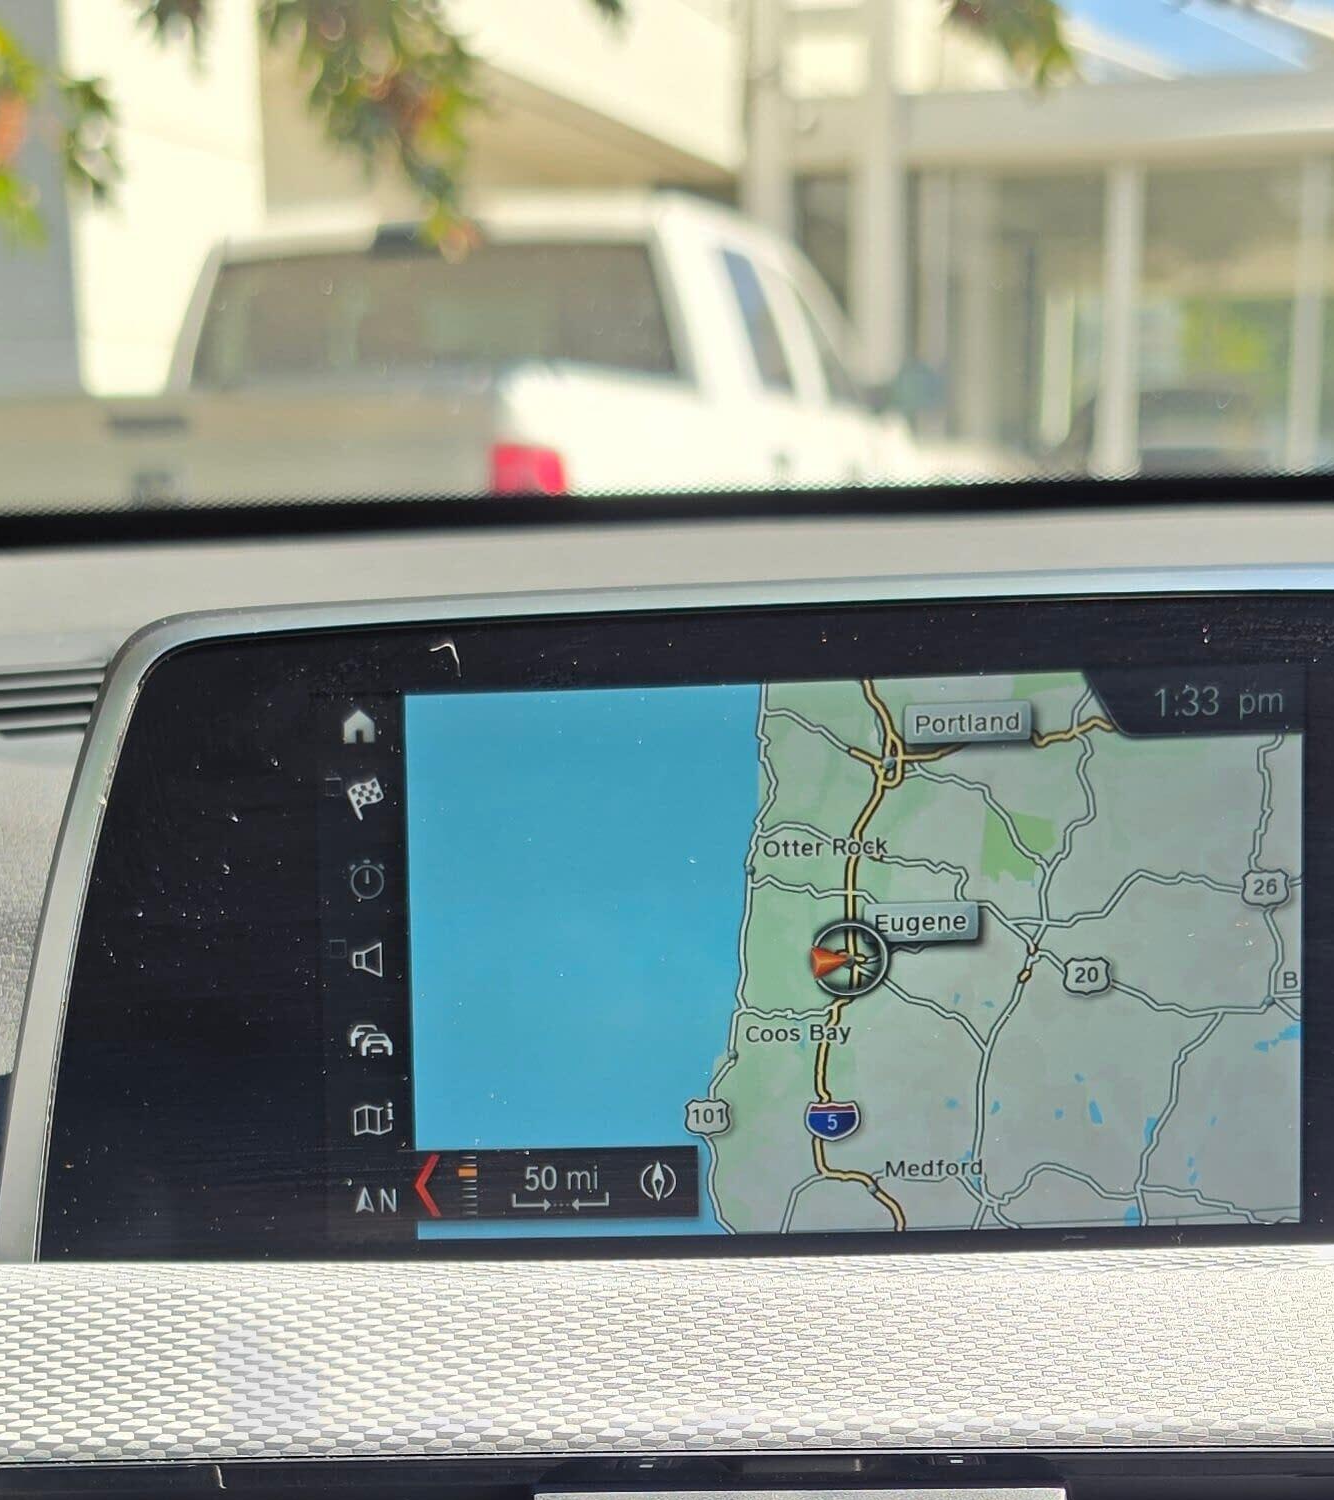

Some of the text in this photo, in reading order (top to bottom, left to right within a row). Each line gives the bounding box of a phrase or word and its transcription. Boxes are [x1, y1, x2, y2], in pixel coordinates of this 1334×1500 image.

[1155, 687, 1284, 719] 1:33 pm
[914, 711, 1021, 736] Portland
[763, 835, 889, 859] Otter Rock
[1253, 877, 1279, 898] 26
[873, 911, 968, 937] Eugene
[1074, 966, 1100, 985] 20
[744, 1022, 852, 1047] Coos Bay
[691, 1107, 726, 1126] 101
[826, 1112, 839, 1131] 5
[524, 1165, 599, 1192] 50 mi
[883, 1157, 984, 1179] Medford
[380, 1188, 398, 1214] N
